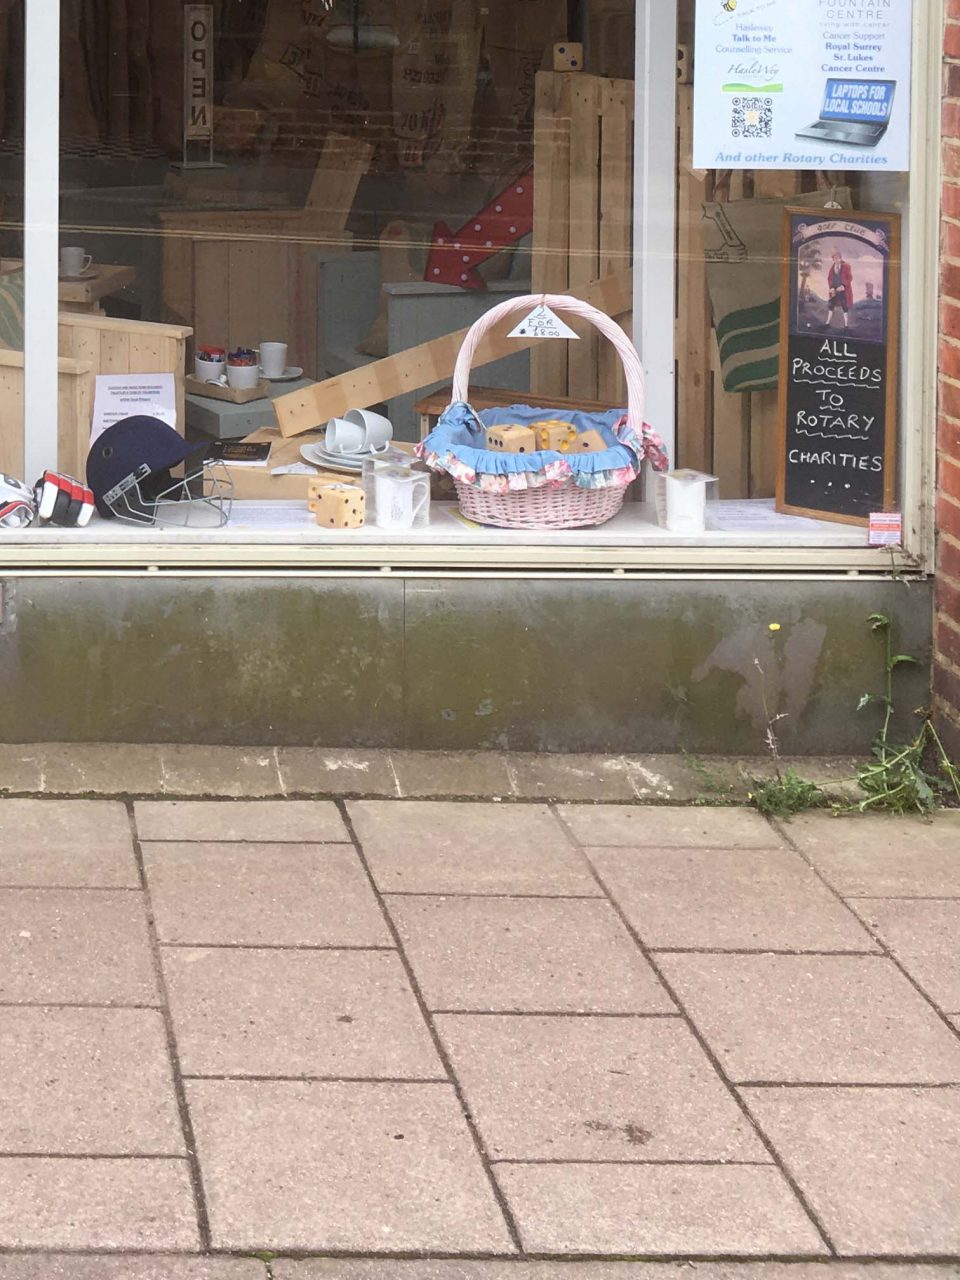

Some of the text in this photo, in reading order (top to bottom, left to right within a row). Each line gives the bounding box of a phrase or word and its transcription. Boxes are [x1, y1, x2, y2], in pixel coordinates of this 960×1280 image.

[826, 9, 883, 19] CENTRE
[732, 34, 750, 42] Talk
[763, 34, 776, 42] Me
[822, 31, 885, 41] Cancer Support
[715, 44, 793, 54] Counselling Service
[825, 42, 882, 52] Royal Surrey
[847, 53, 874, 61] Lukes
[821, 64, 885, 72] Cancer Centre
[832, 84, 887, 100] LAPTOPS FOR
[824, 99, 888, 116] LOCAL SCHOOLS
[715, 152, 888, 165] And other Rotary Charities
[820, 339, 857, 358] ALL
[792, 358, 882, 383] PROCEEDS
[815, 389, 843, 407] TO
[796, 410, 875, 432] ROTARY
[788, 449, 883, 472] CHARITIES
